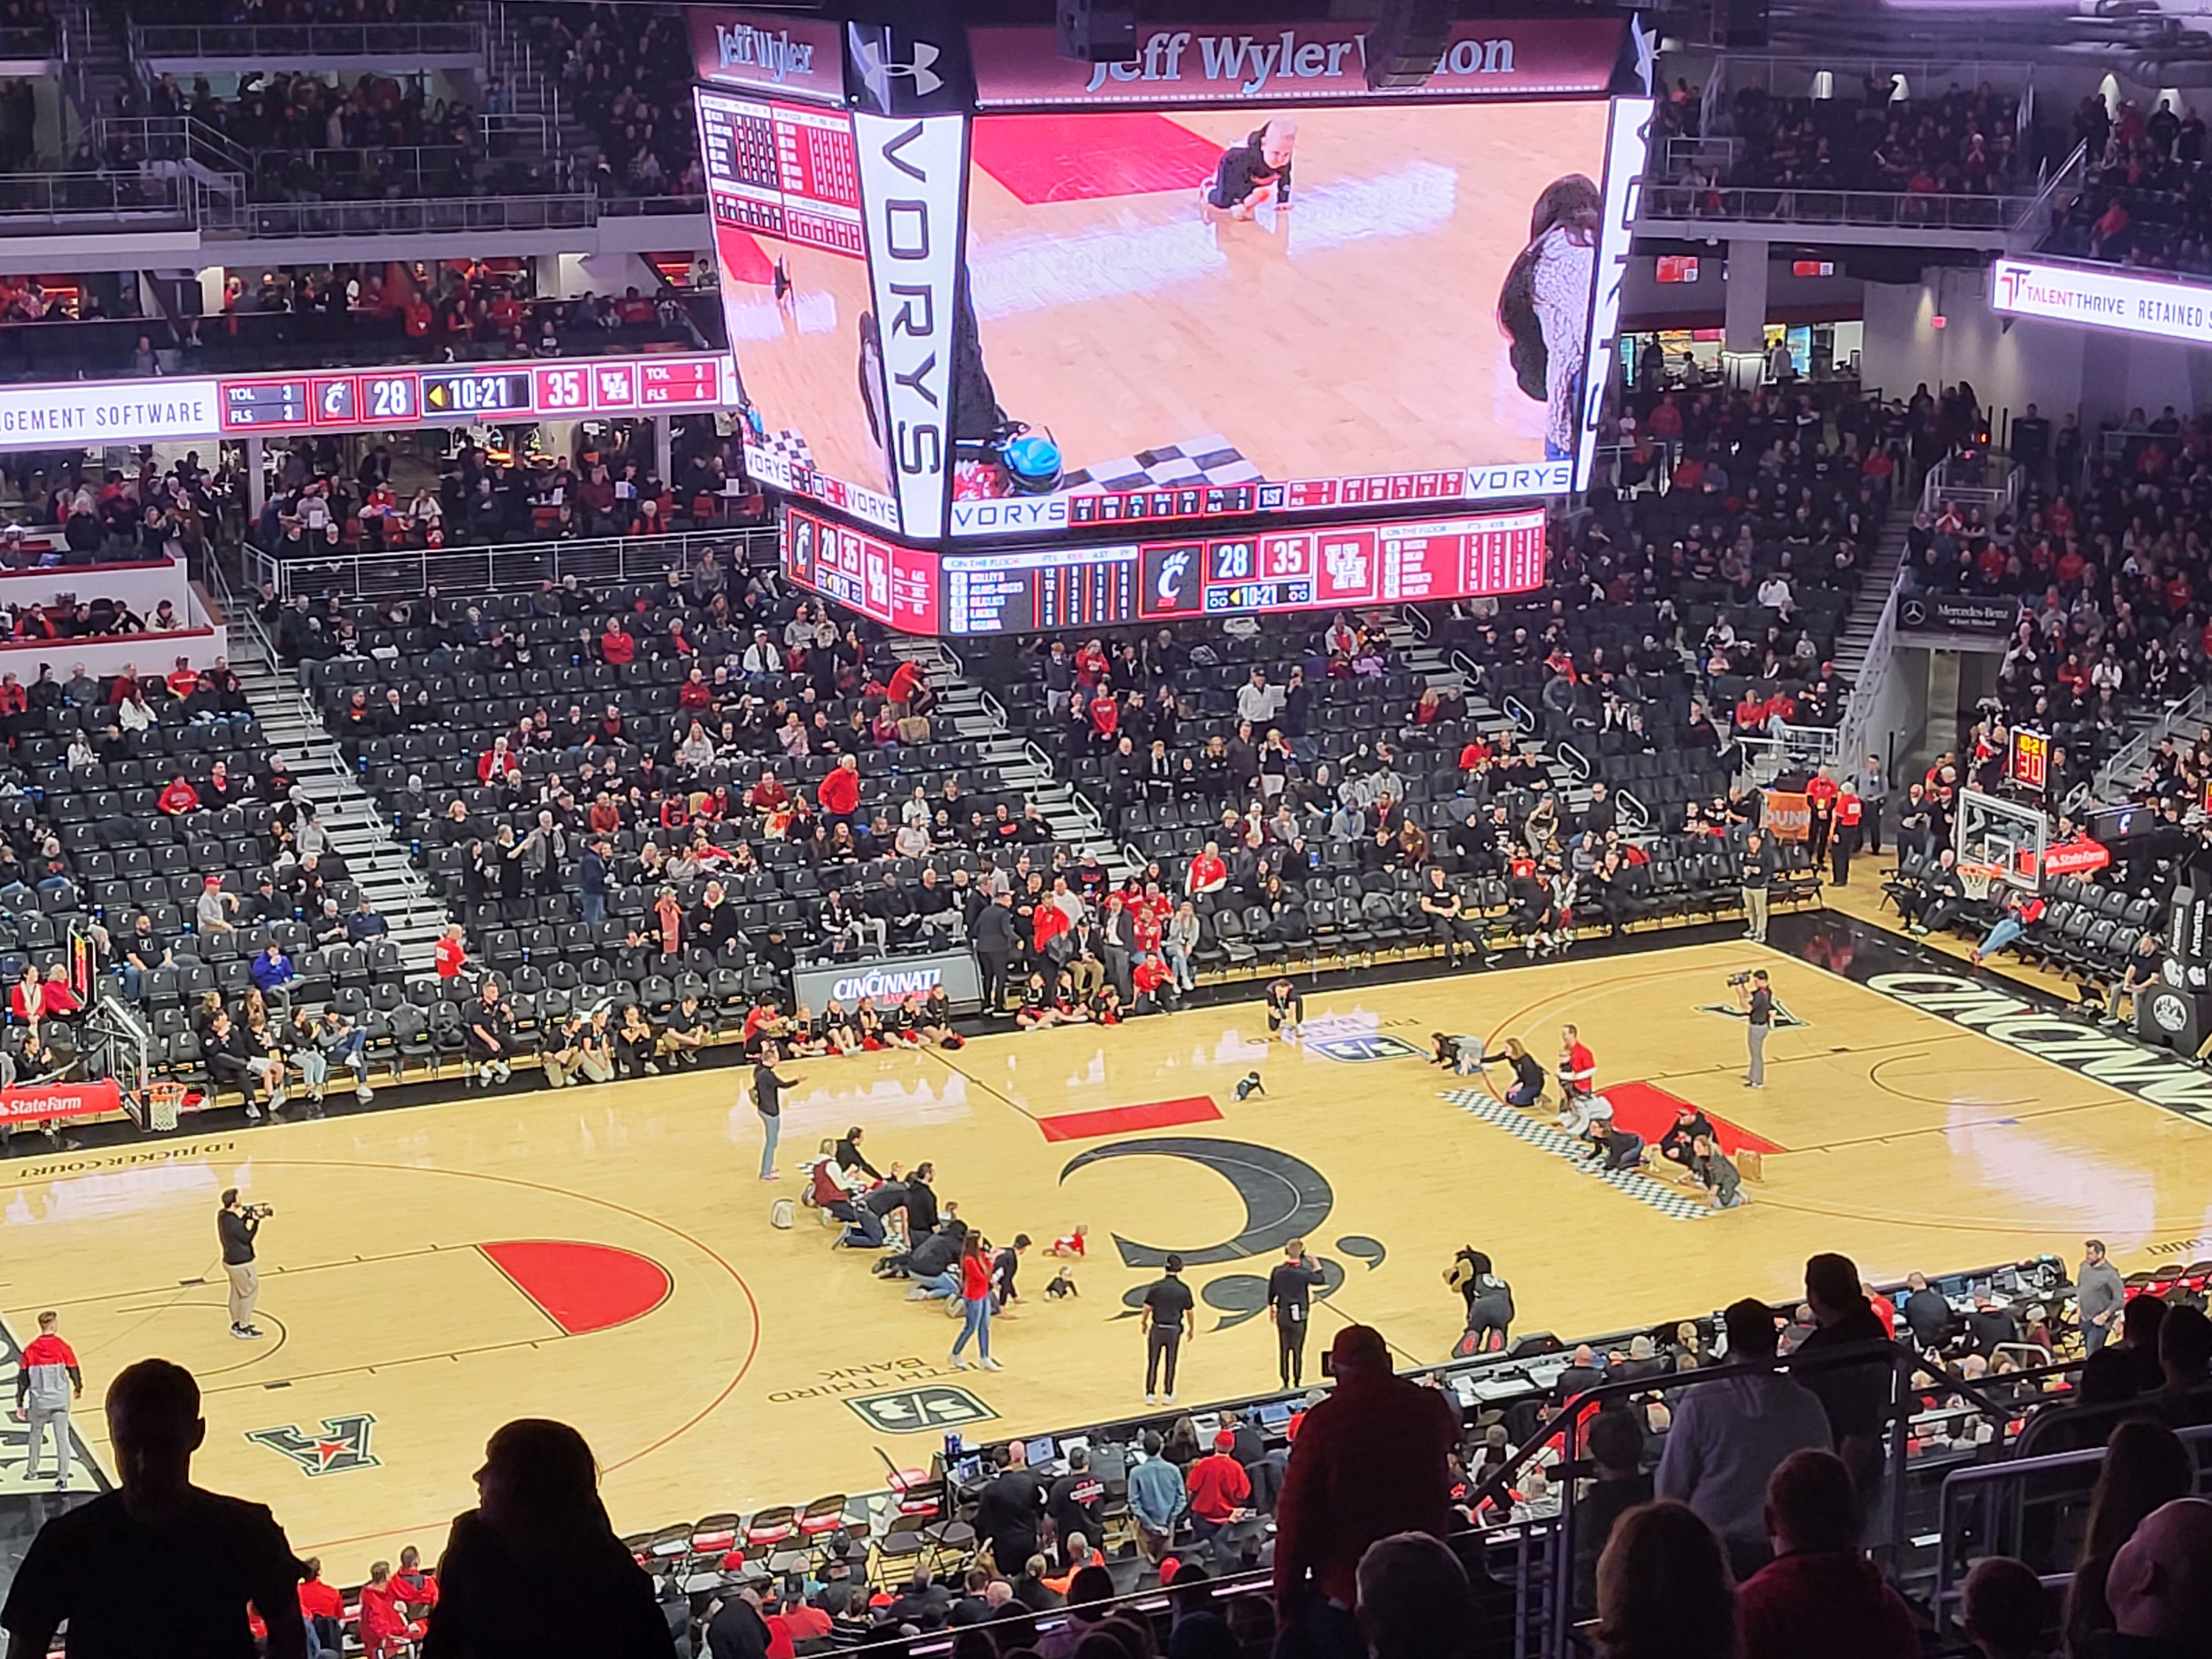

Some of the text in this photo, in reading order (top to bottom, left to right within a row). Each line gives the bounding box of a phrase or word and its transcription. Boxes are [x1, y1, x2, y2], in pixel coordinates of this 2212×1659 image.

[716, 23, 814, 82] Jeff Wyler
[1198, 31, 1353, 94] Wyler
[881, 119, 941, 474] VORYS
[2138, 299, 2203, 327] RETAINED
[646, 364, 703, 380] TOL 3
[228, 384, 292, 402] TOL 3
[373, 380, 407, 416] 28
[449, 378, 508, 409] 10:21
[547, 372, 580, 406] 35
[647, 384, 703, 401] FLS 6
[0, 402, 203, 432] GEMENT SOFTWARE
[230, 406, 293, 424] FLS 3
[747, 451, 790, 483] VORYS
[1469, 467, 1568, 490] VORYS
[847, 488, 897, 524] VORYS
[1262, 488, 1282, 505] 1ST
[954, 501, 1066, 527] VORYS
[1402, 527, 1418, 535] THE
[1420, 525, 1447, 534] FLOOR
[821, 528, 836, 563] 28
[843, 538, 858, 572] 35
[1273, 540, 1302, 573] 35
[951, 560, 967, 568] ON
[969, 559, 987, 567] THE
[989, 557, 1019, 566] FLOOR
[1218, 545, 1249, 577] 28
[1241, 585, 1277, 606] 10:21
[1938, 604, 2008, 619] Mercedes-Benz
[2190, 900, 2205, 957] Ameritas
[833, 968, 941, 1001] CINCINNATI
[17, 1160, 102, 1178] COURT
[109, 1146, 199, 1166] JUCKER
[818, 1357, 931, 1380] BANK
[768, 1378, 889, 1402] THIRD
